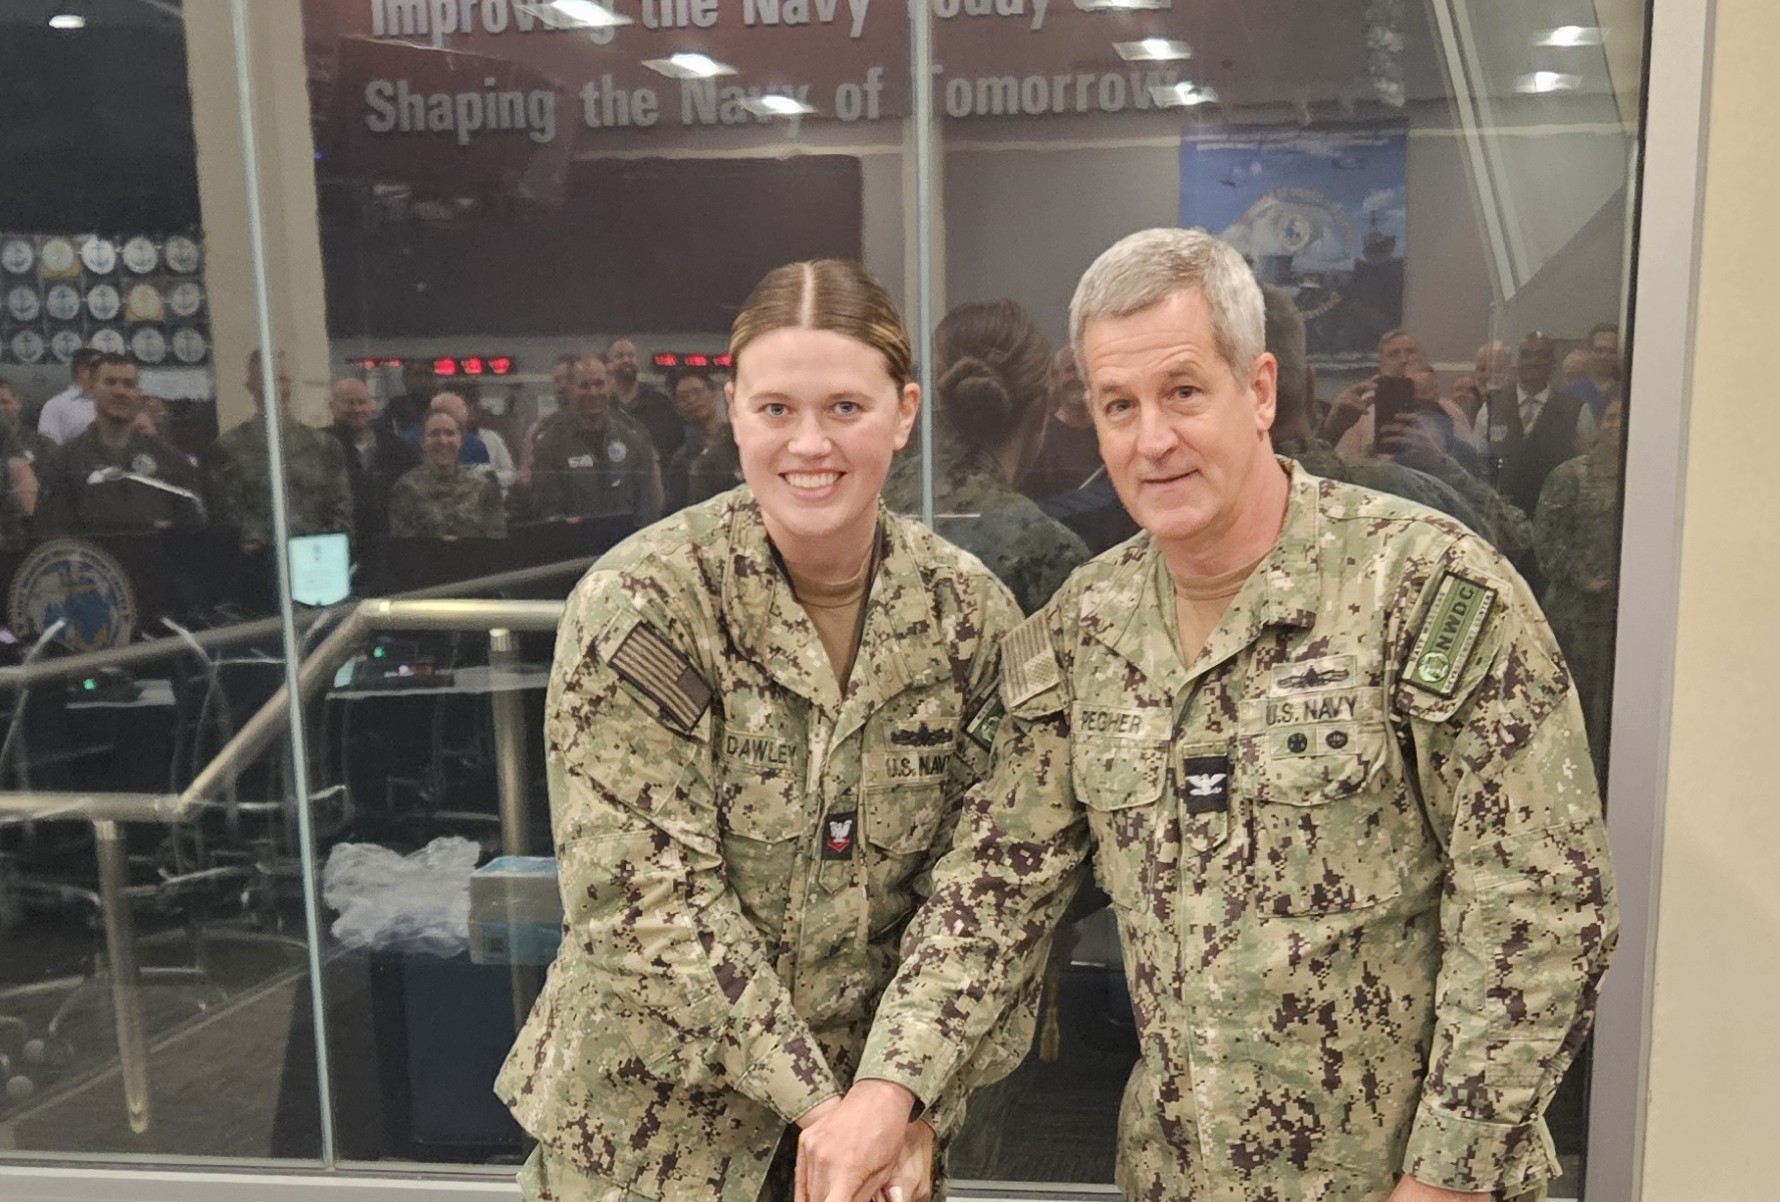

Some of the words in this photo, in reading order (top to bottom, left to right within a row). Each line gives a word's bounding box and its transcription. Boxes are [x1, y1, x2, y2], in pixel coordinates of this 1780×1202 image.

[364, 77, 556, 145] Shaping
[581, 74, 660, 128] the
[835, 67, 884, 121] of
[930, 64, 1178, 117] omorrow
[1436, 586, 1474, 650] NWDC
[1266, 702, 1299, 726] U.S.
[1303, 695, 1358, 721] NAVY
[727, 735, 797, 767] DAWLEY
[886, 756, 917, 778] U.S.
